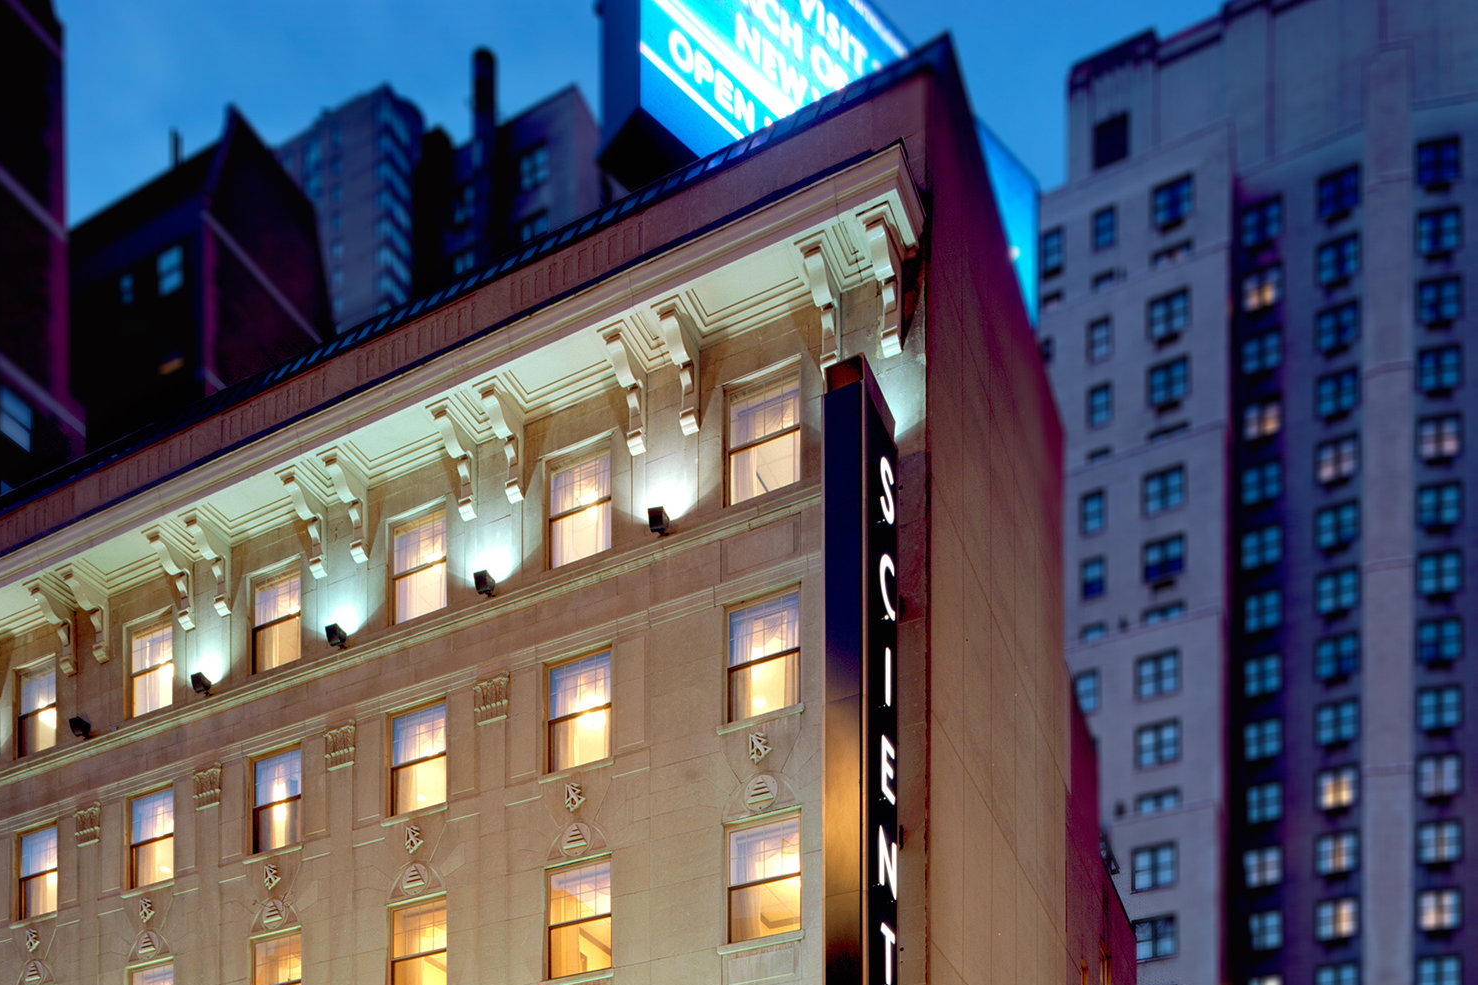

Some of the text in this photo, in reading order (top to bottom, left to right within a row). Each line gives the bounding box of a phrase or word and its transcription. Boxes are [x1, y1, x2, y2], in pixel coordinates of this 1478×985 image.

[668, 29, 756, 133] OPEN
[736, 13, 807, 105] NEW
[800, 0, 867, 75] VISIT
